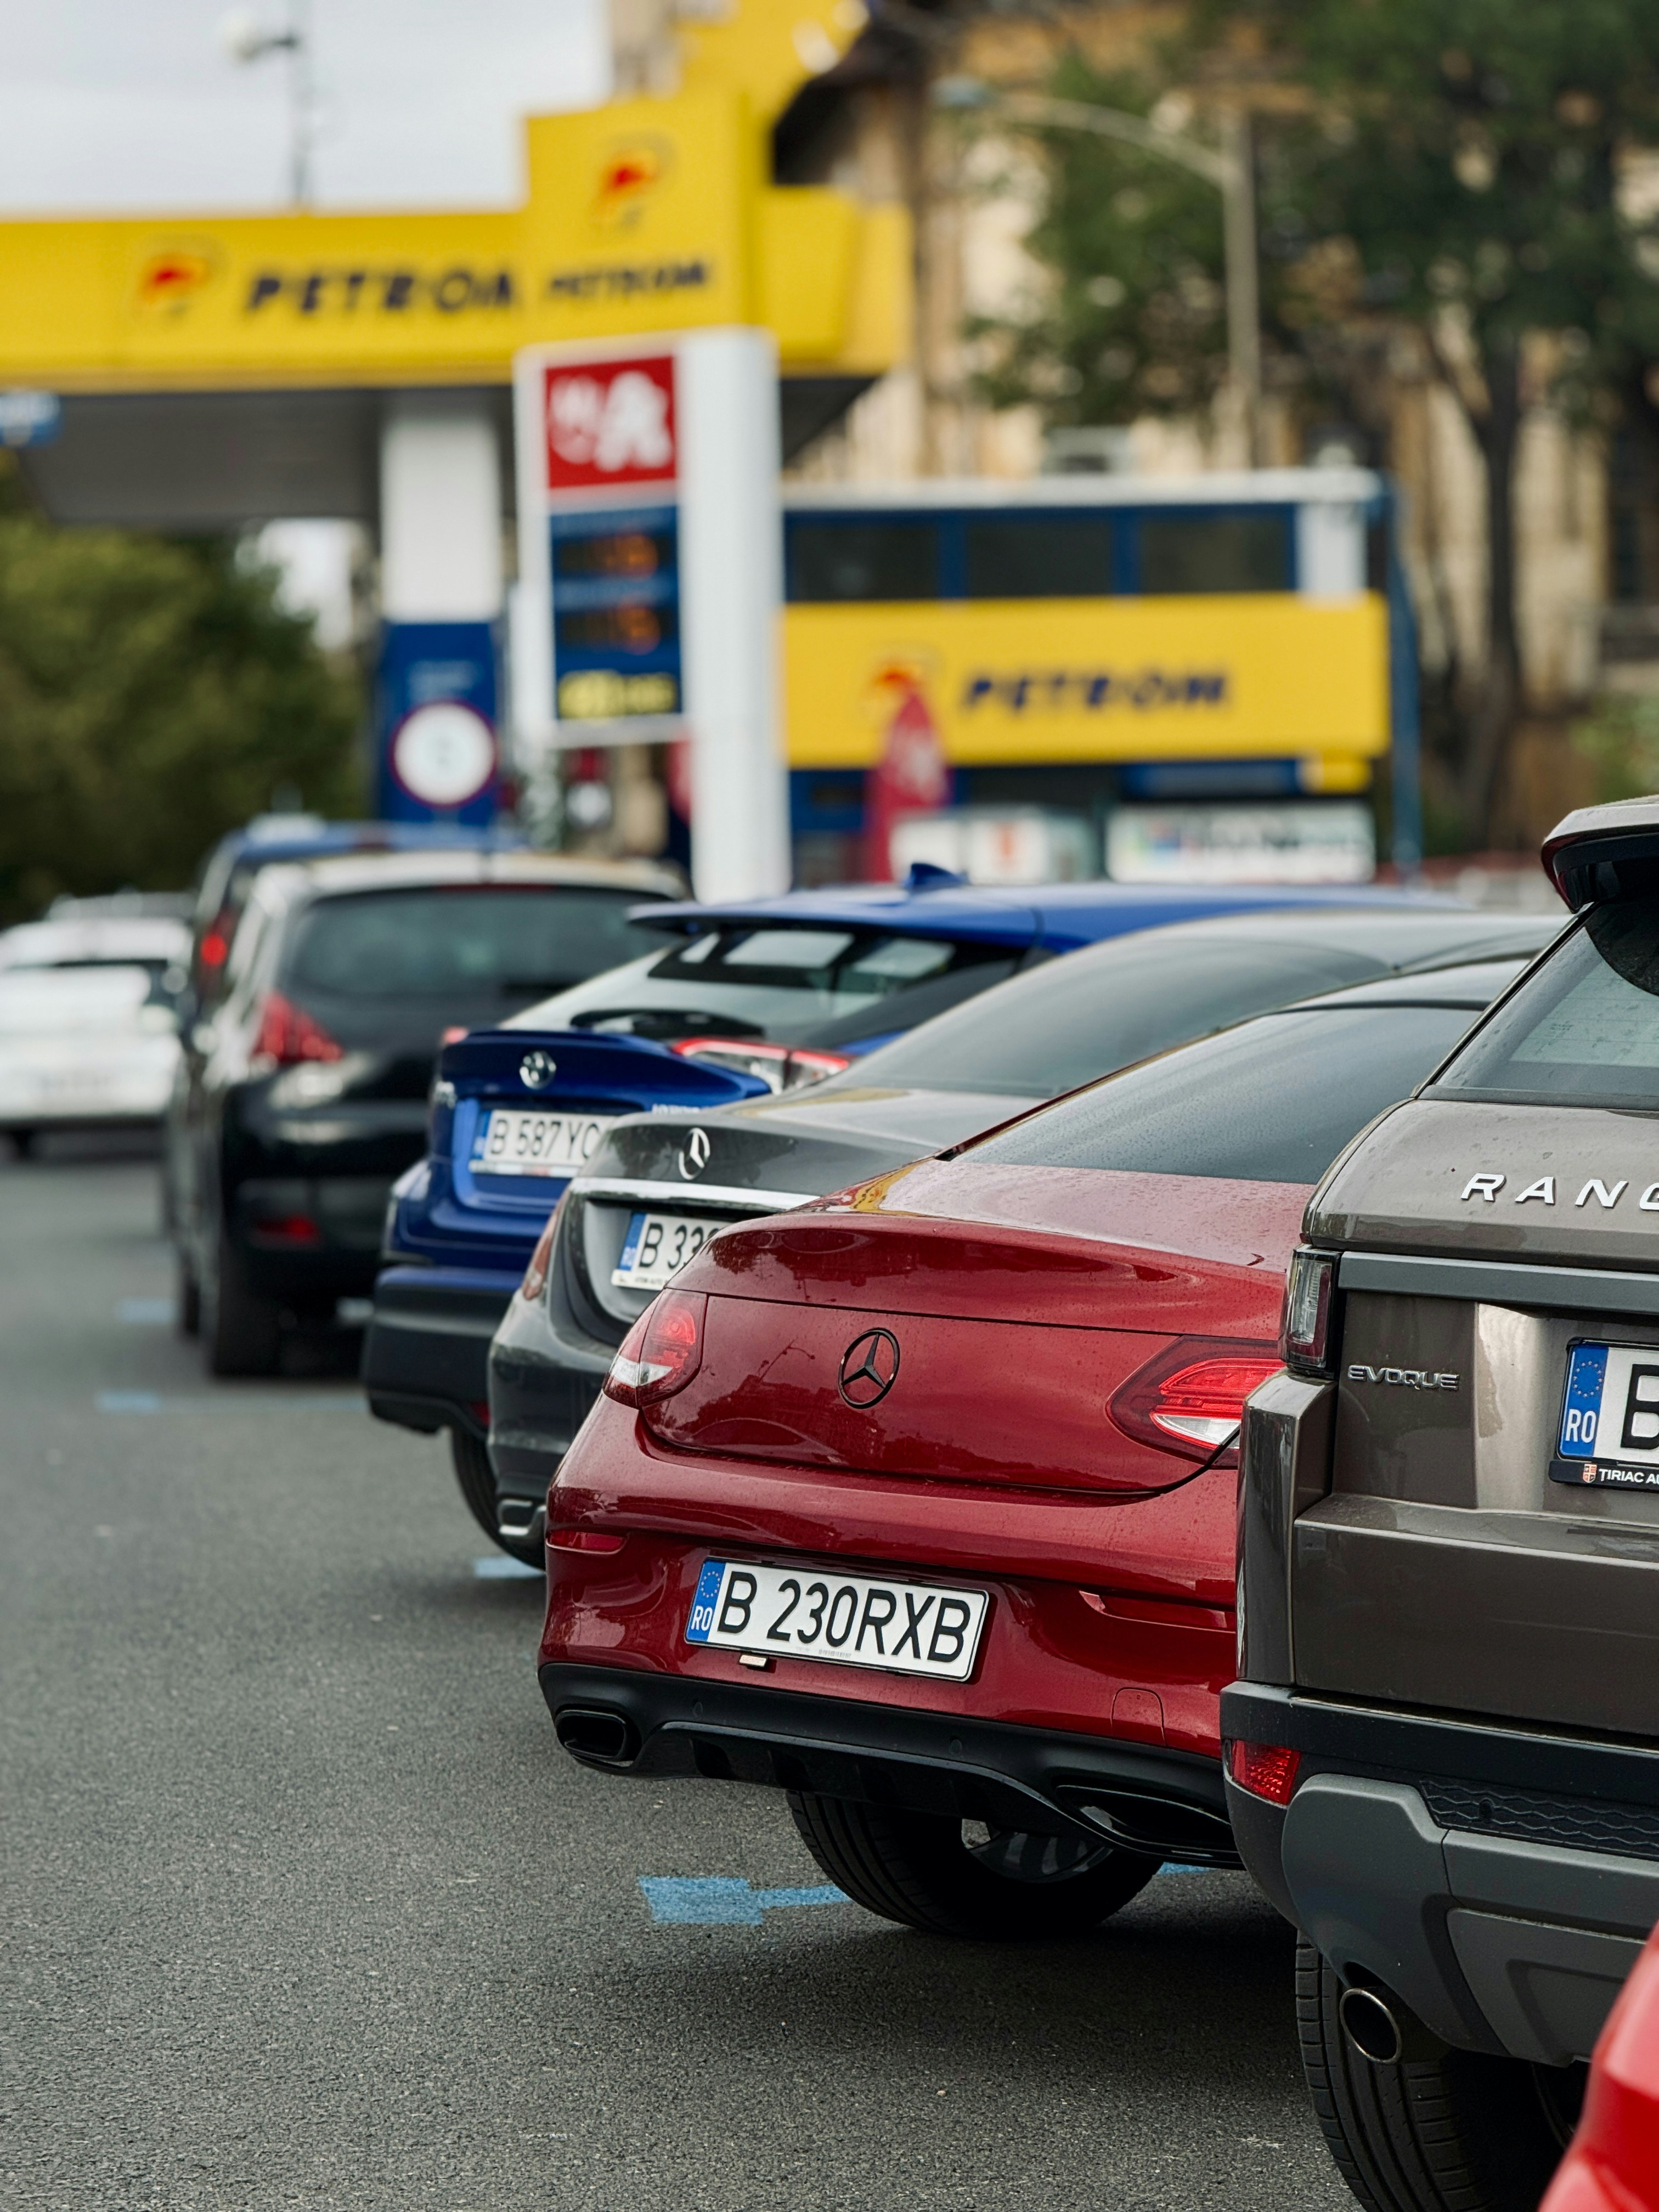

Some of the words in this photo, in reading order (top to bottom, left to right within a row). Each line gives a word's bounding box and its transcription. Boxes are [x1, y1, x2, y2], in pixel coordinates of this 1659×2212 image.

[490, 1118, 509, 1155] B
[638, 1222, 663, 1268] B
[1347, 1364, 1460, 1391] EVOQUE
[1565, 1408, 1597, 1443] RO
[1598, 1468, 1645, 1483] TIRIAC
[690, 1605, 713, 1632] RO
[717, 1571, 757, 1634] B
